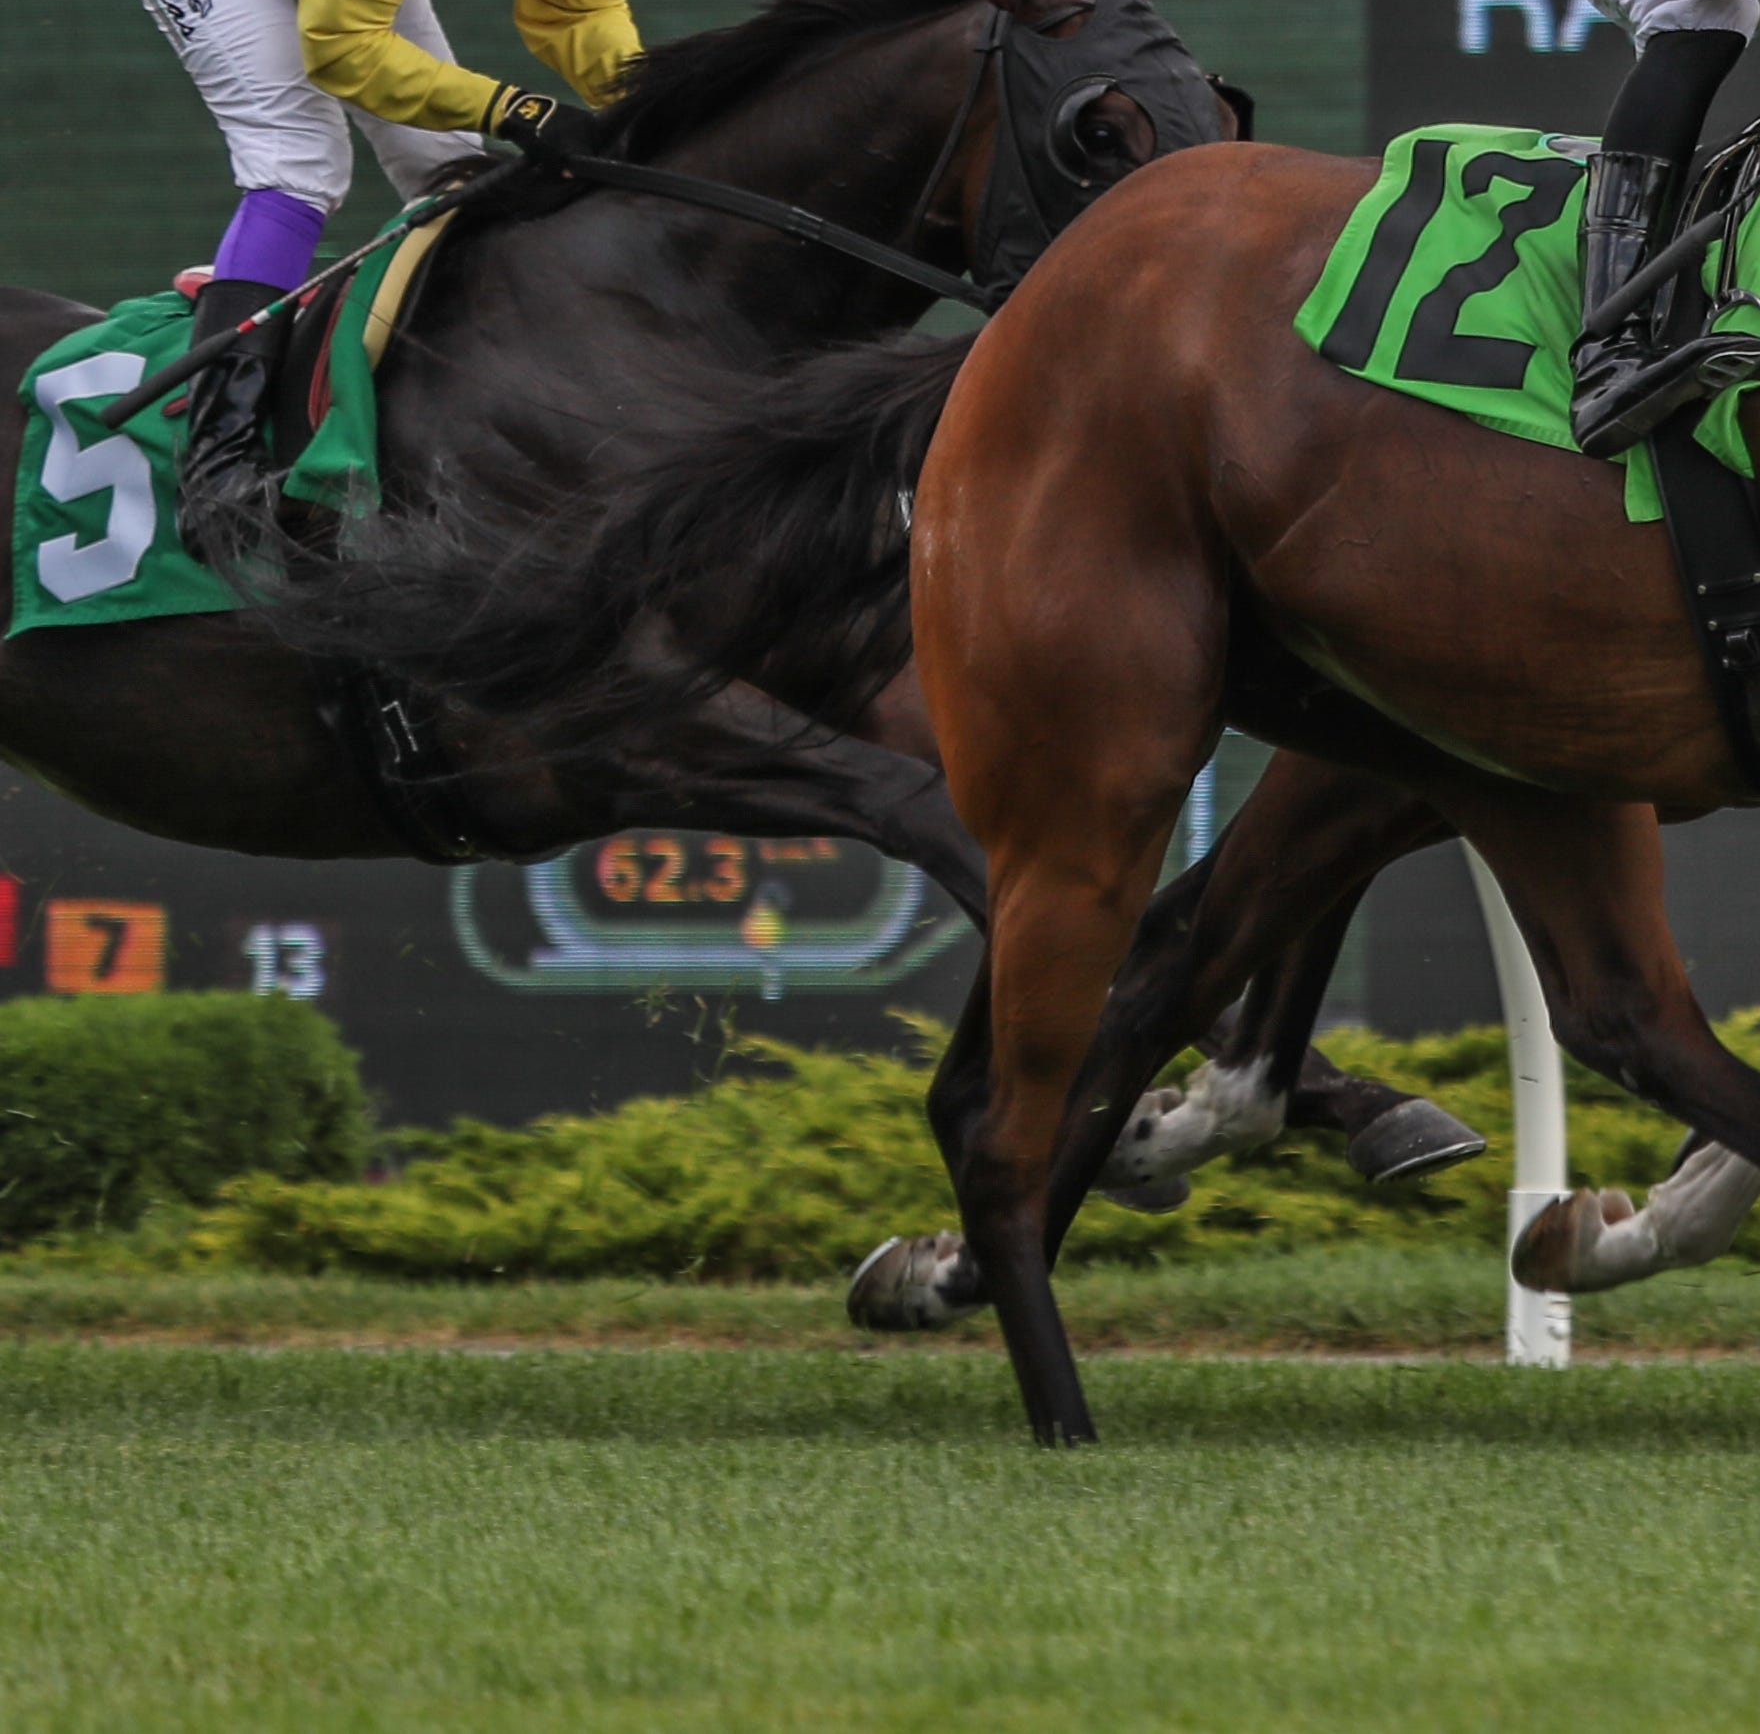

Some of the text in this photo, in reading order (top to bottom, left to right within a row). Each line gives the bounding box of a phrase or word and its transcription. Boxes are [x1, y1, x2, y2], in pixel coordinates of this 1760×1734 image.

[1318, 138, 1587, 390] 12
[34, 351, 157, 604] 5
[595, 836, 746, 902] 62.3
[83, 913, 327, 1001] 7 13
